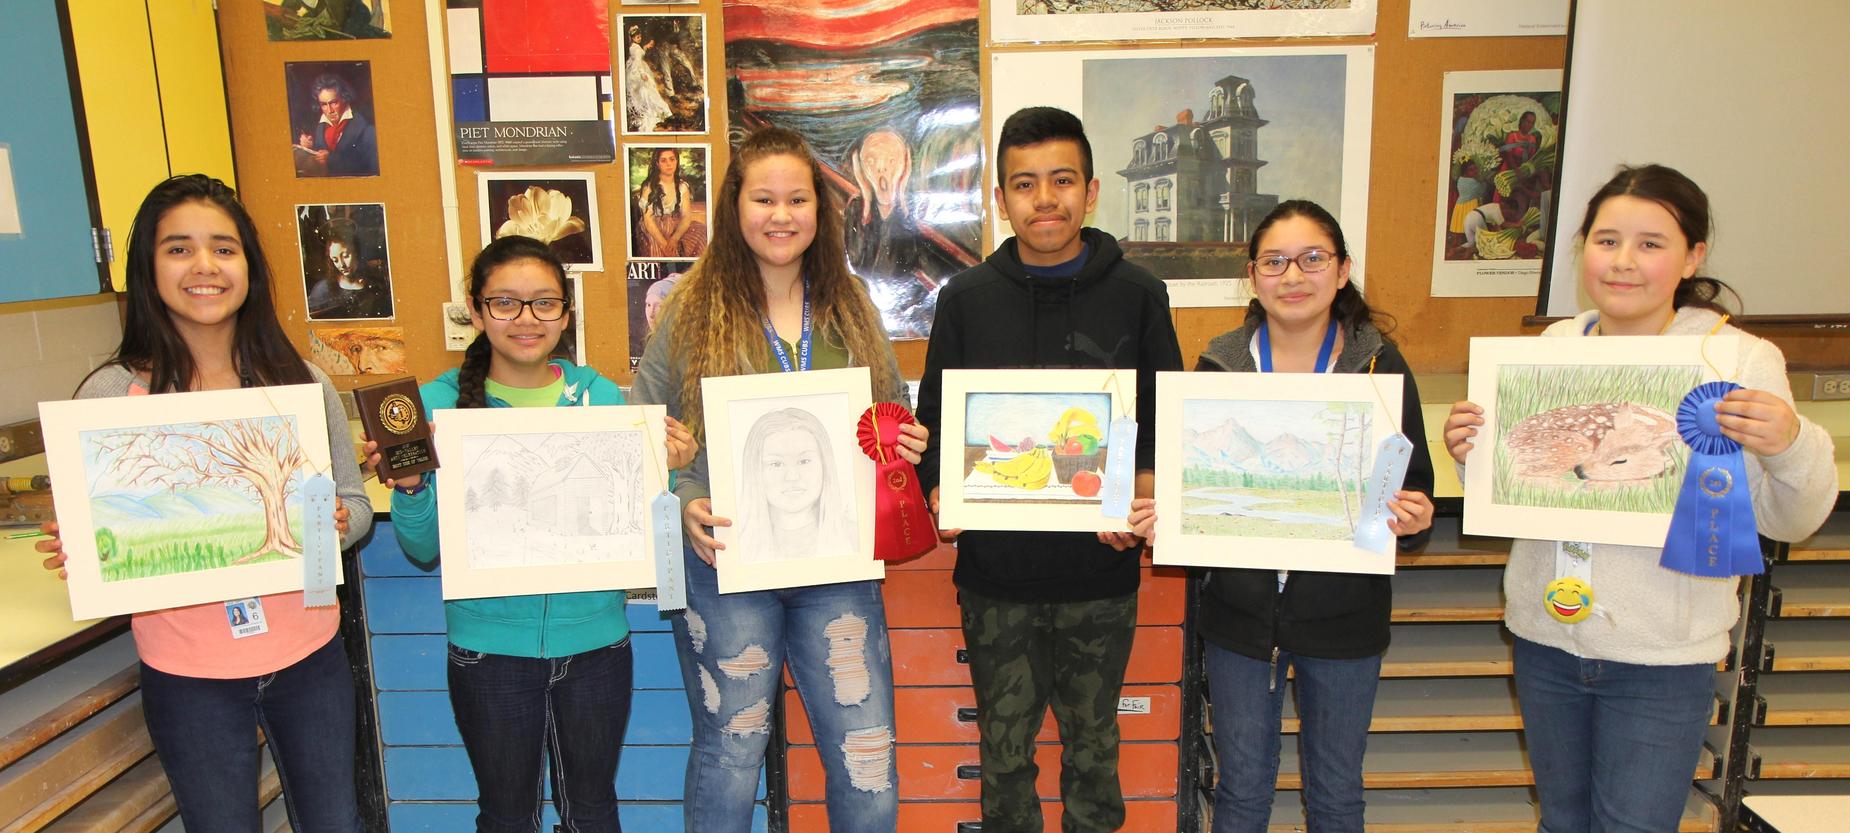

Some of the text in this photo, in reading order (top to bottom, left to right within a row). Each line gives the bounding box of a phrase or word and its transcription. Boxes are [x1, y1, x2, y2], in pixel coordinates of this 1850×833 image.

[460, 126, 567, 139] PIET MONDRIAN
[628, 262, 659, 280] ART
[773, 340, 792, 373] WMS CUBS
[801, 340, 809, 356] CUBS
[899, 500, 912, 545] PLACE
[1707, 508, 1719, 567] PLACE
[663, 505, 675, 600] PARTICIPANT
[626, 591, 658, 600] Cardst
[252, 612, 259, 620] 6
